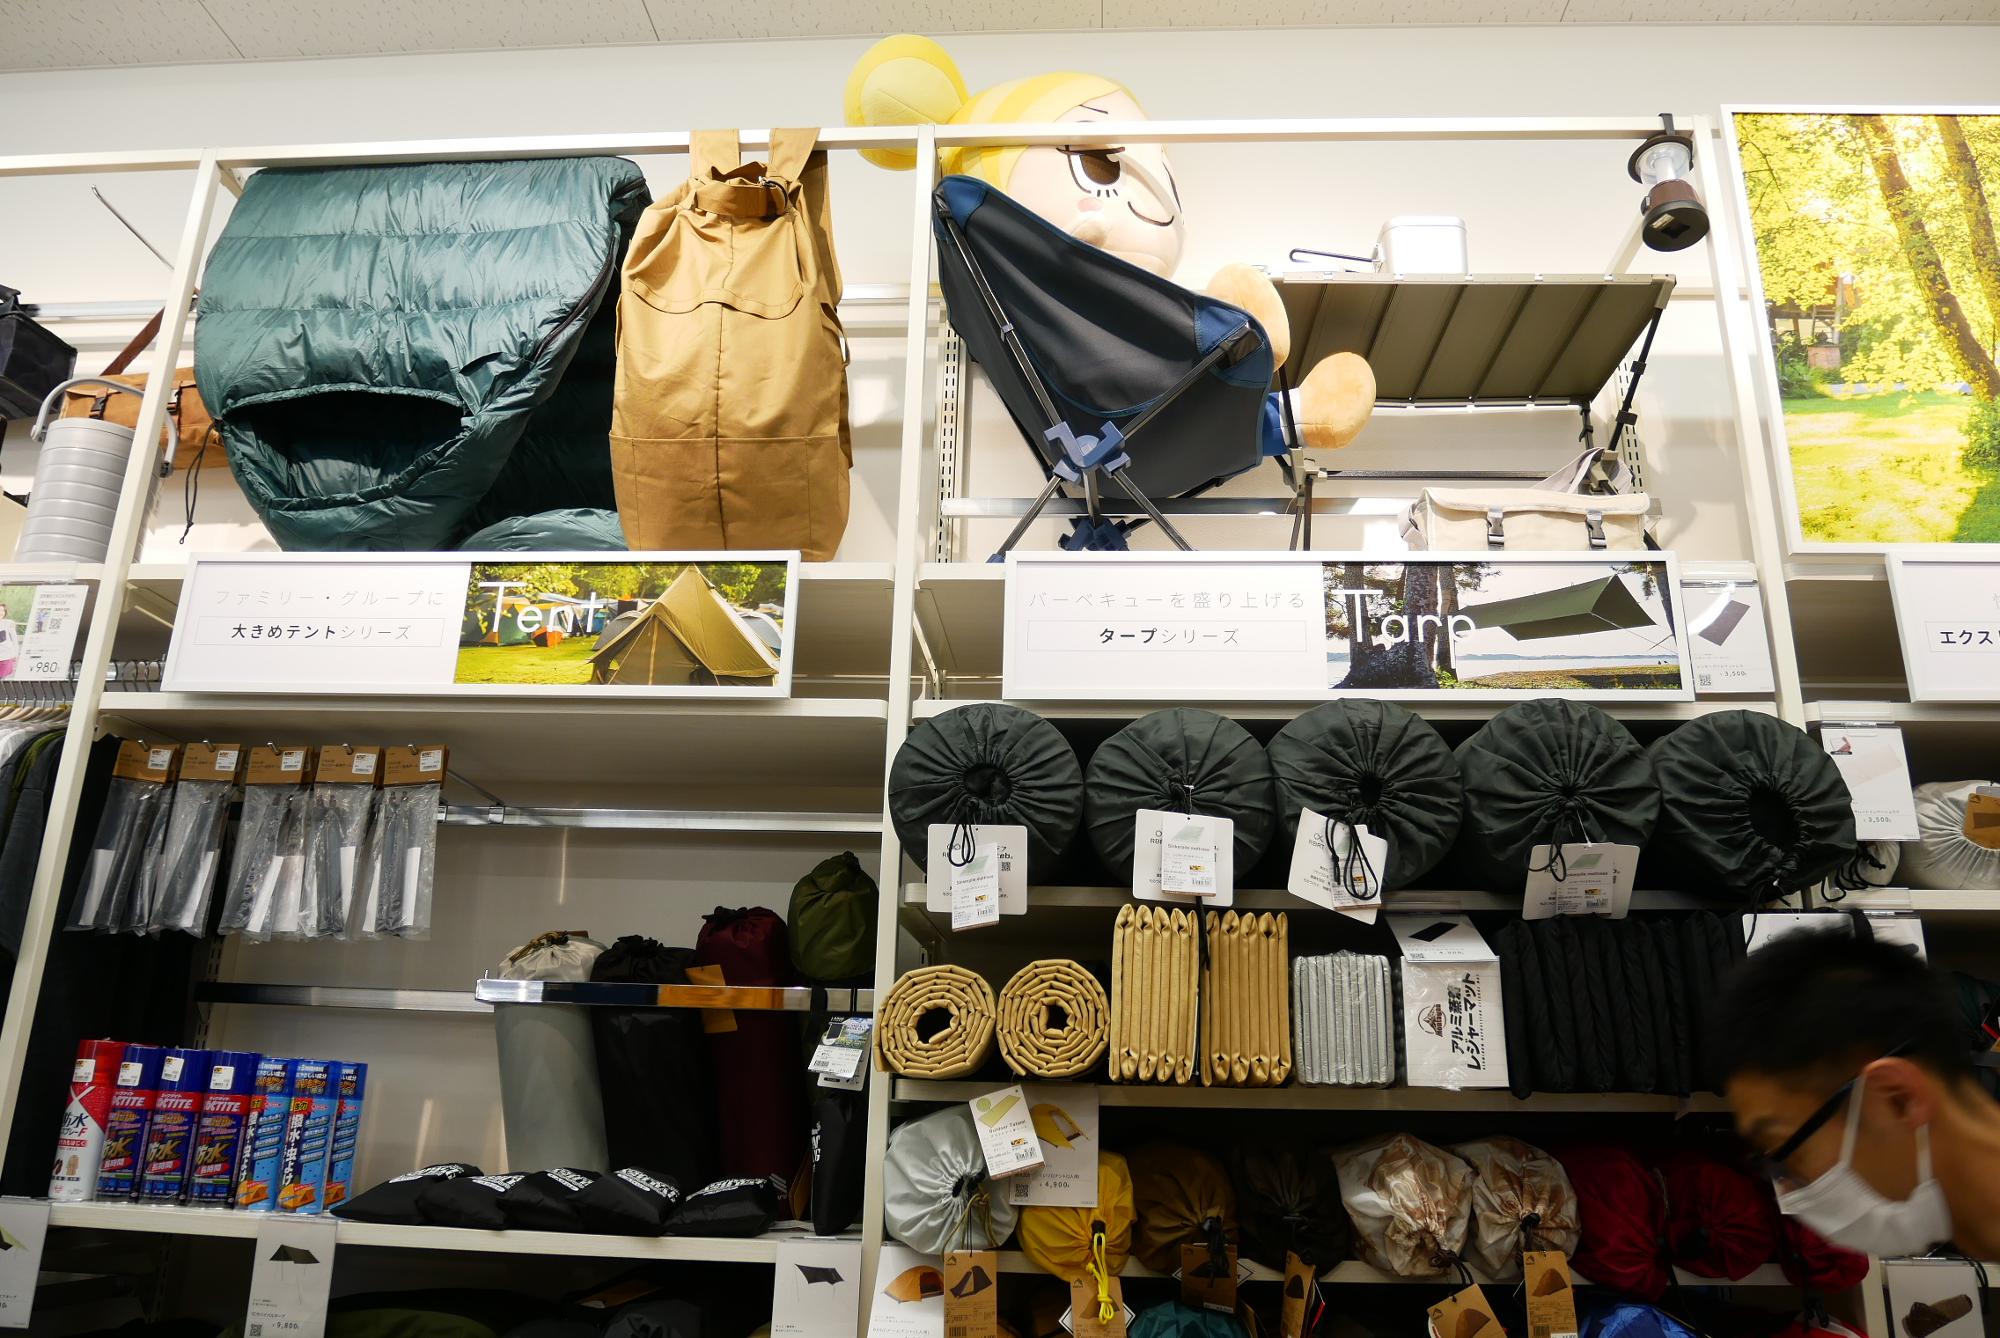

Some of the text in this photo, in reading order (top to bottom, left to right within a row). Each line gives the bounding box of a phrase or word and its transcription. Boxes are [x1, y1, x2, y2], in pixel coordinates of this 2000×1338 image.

[478, 581, 604, 635] Tent
[1028, 590, 1306, 610] バーベキューを盛り上げる
[231, 622, 411, 642] 大きめテントシリーズ
[1099, 626, 1240, 646] タープシリーズ
[1338, 590, 1477, 669] Tarp
[1939, 629, 2000, 645] エクス
[1462, 972, 1481, 1071] レジャーマット
